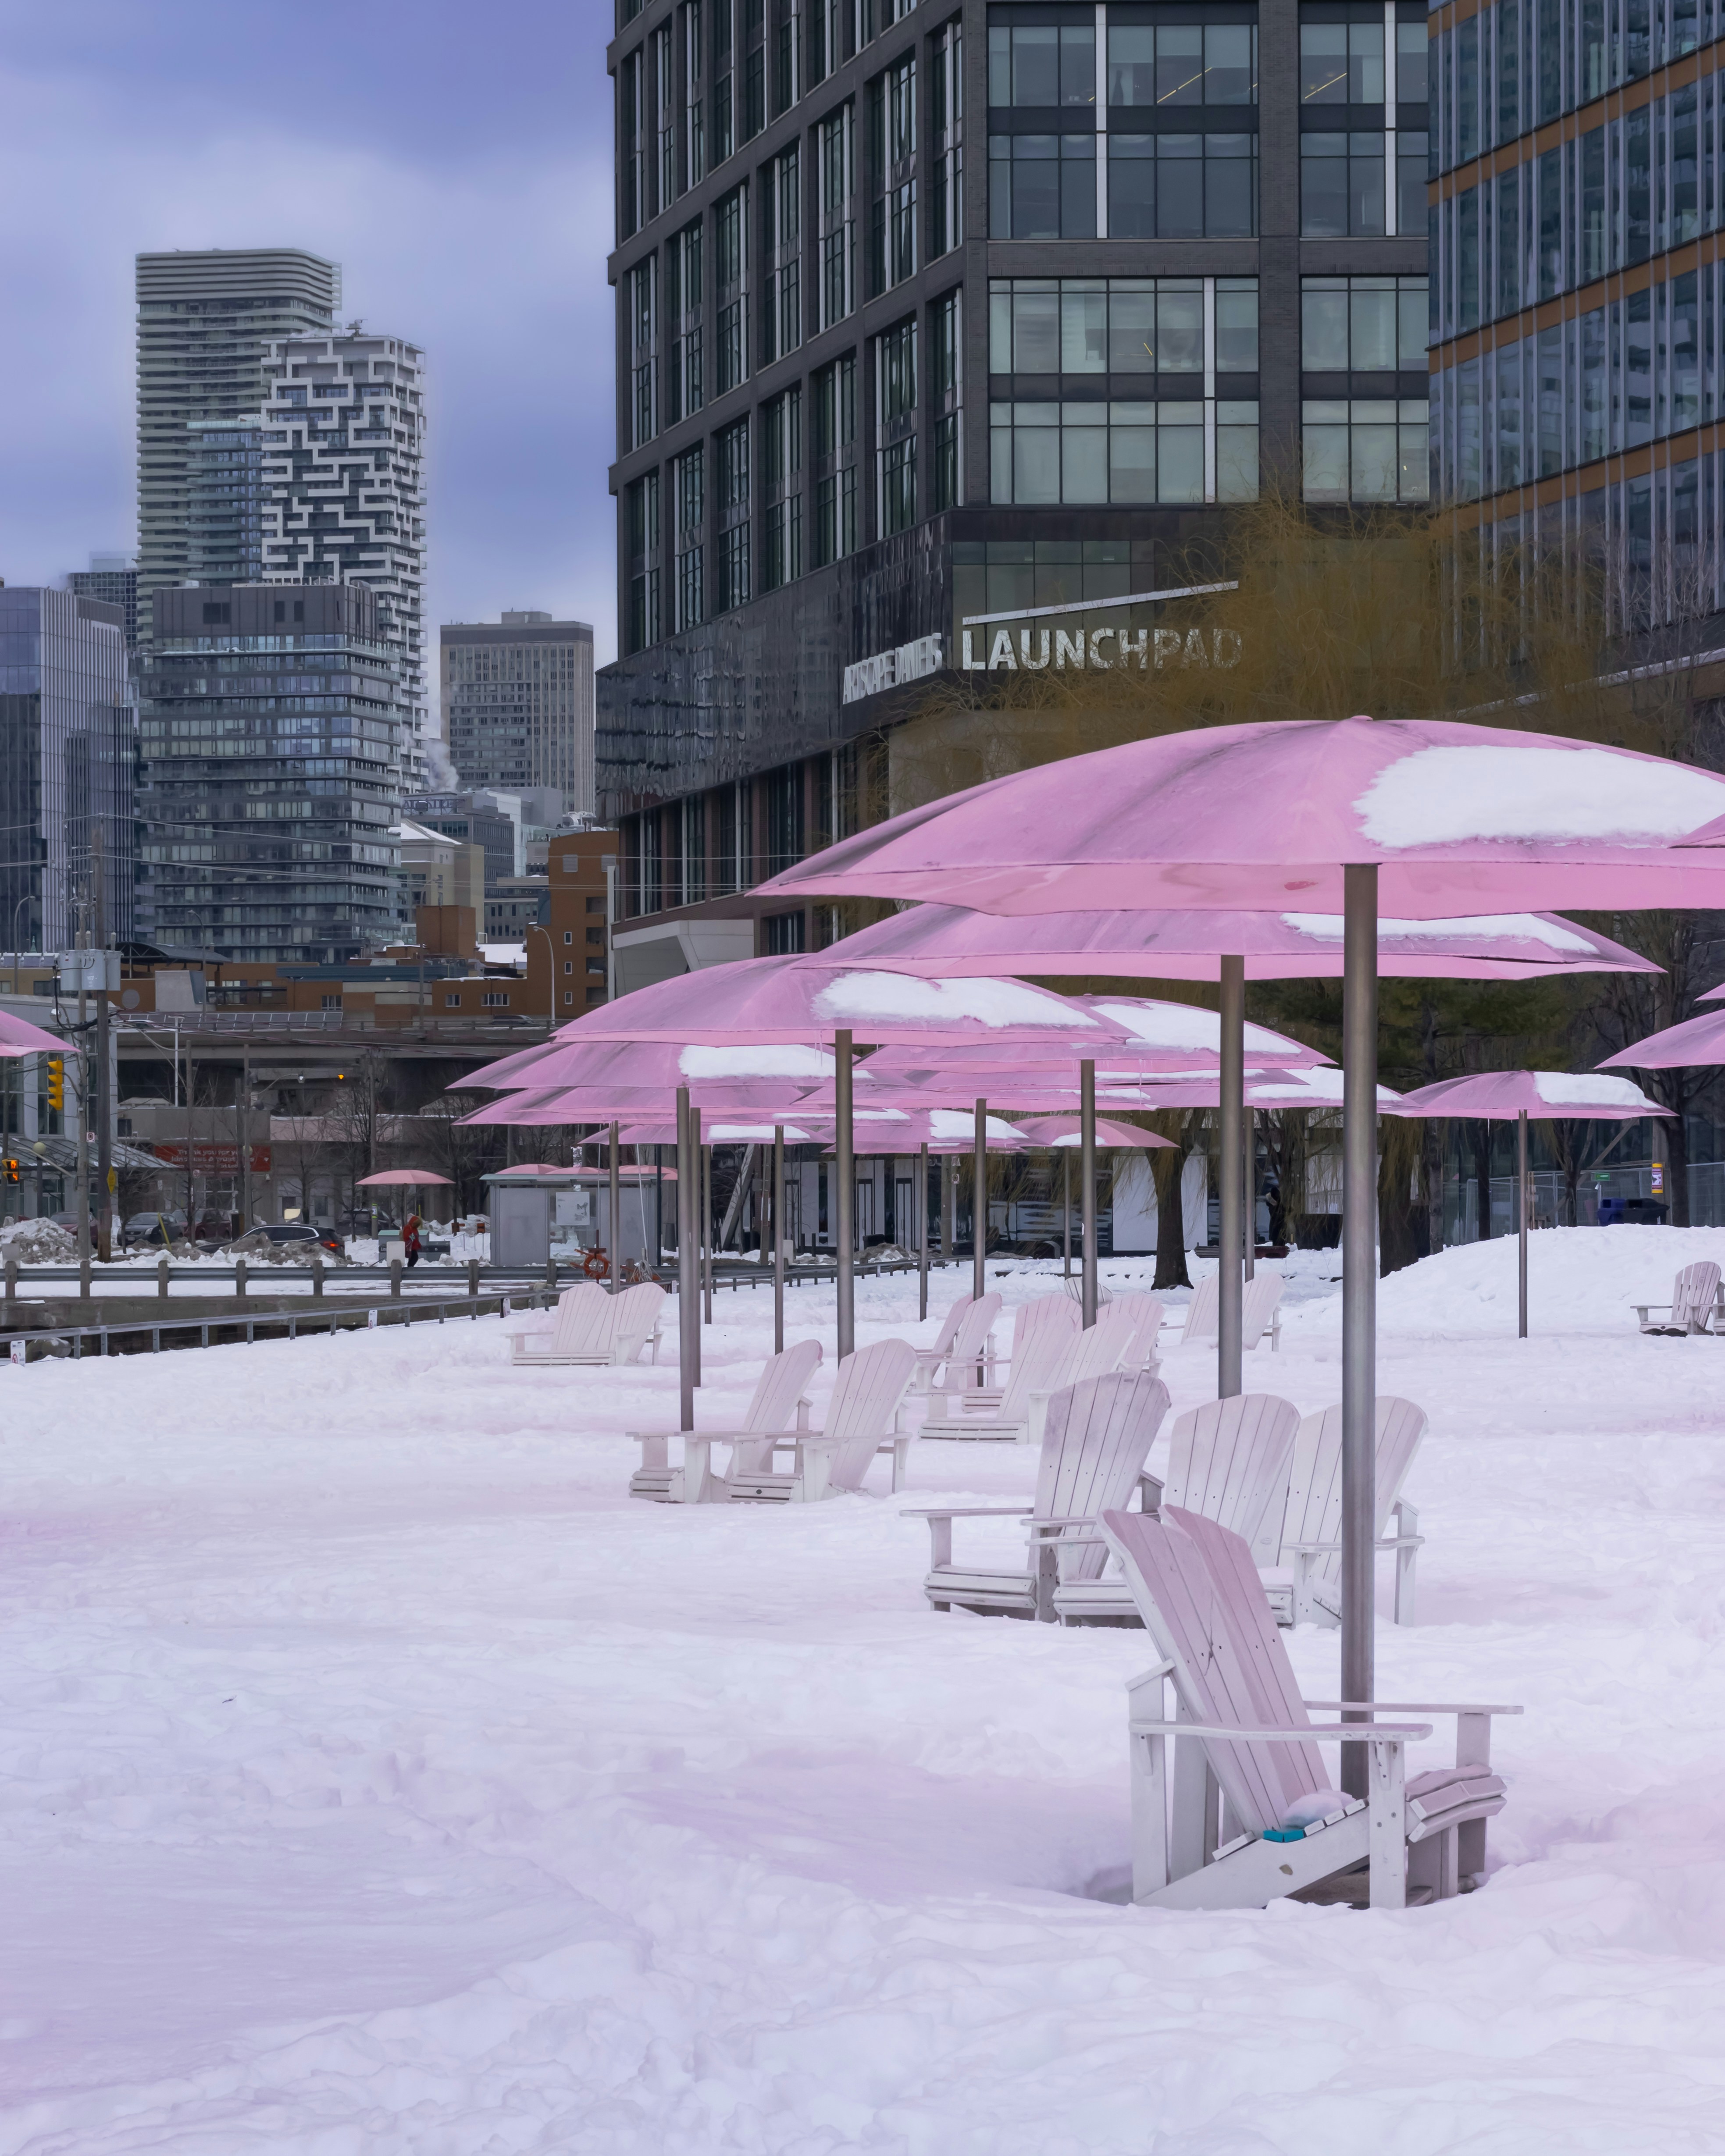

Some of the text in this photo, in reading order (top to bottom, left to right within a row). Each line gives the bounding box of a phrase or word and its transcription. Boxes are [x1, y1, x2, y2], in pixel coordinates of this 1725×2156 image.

[843, 633, 942, 704] ARTSCAPE DANIELS
[962, 628, 1243, 670] LAUNCHPAD
